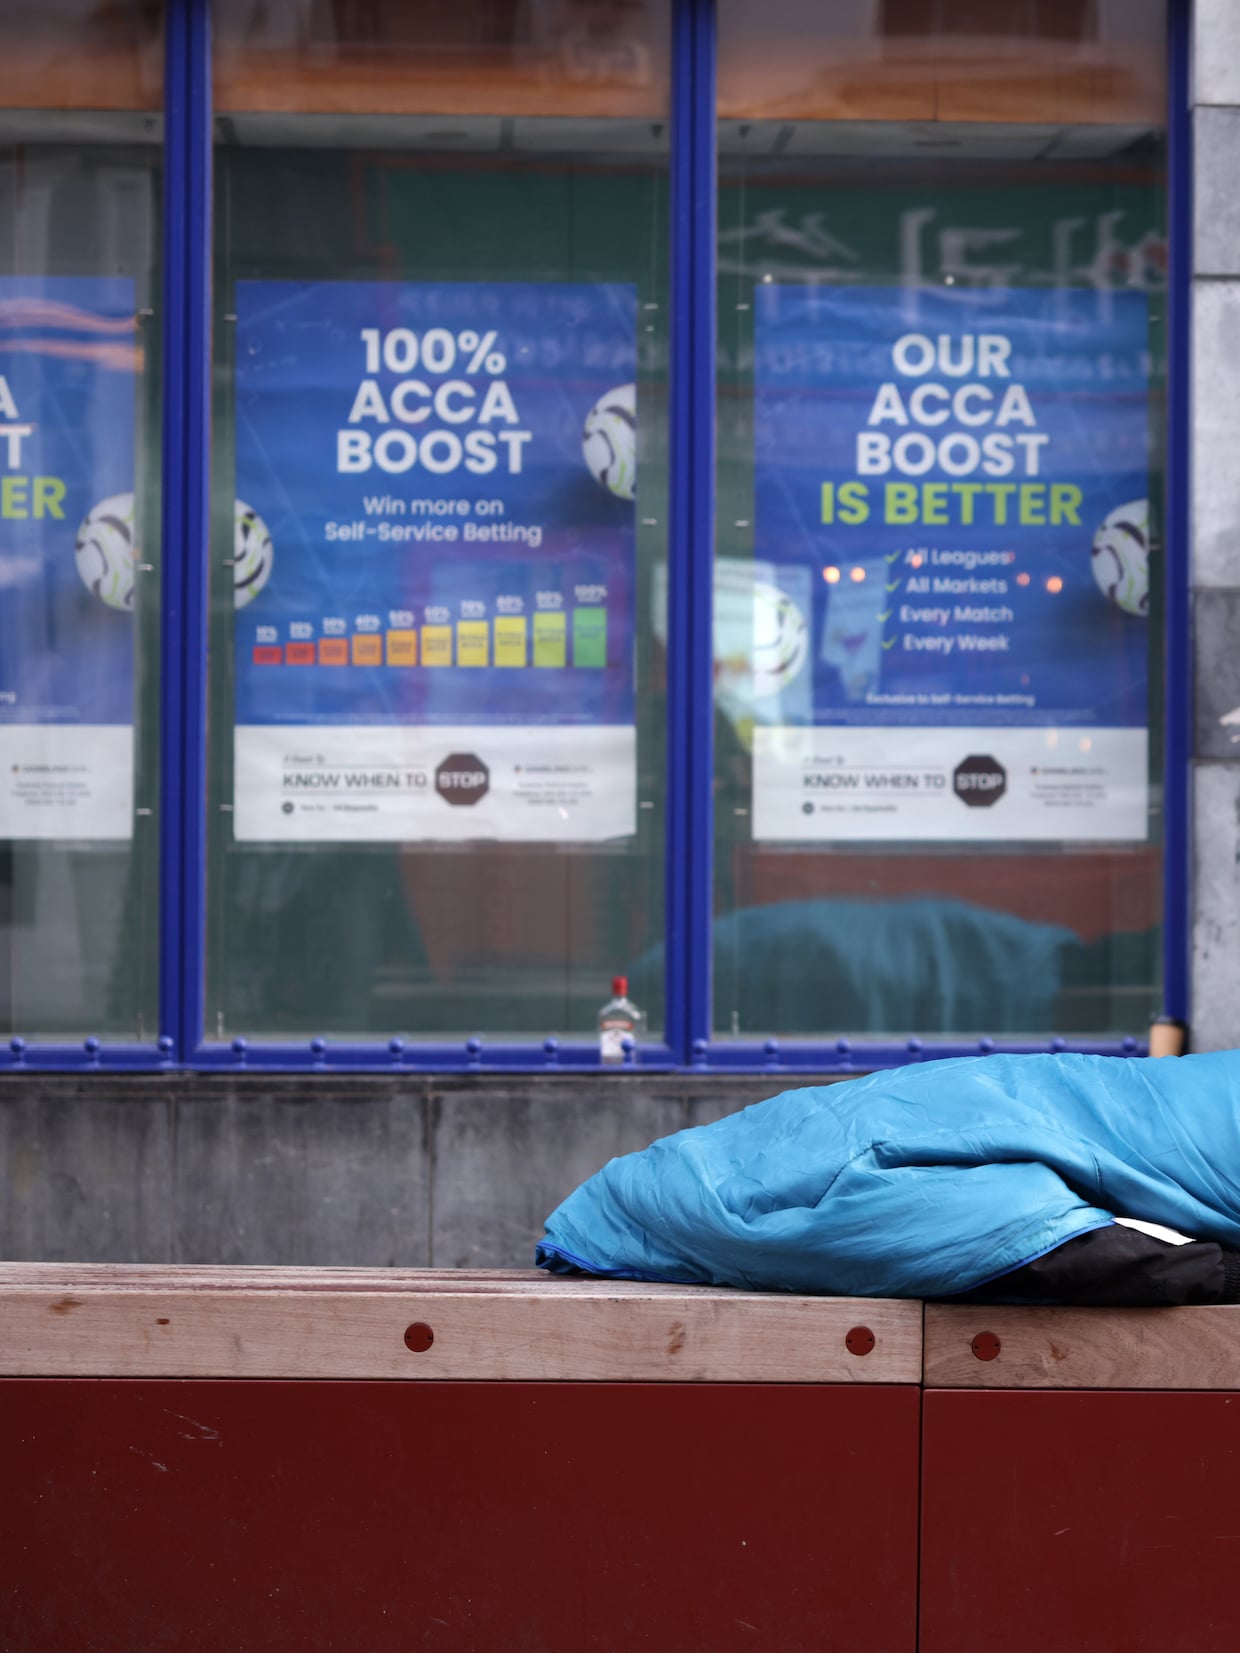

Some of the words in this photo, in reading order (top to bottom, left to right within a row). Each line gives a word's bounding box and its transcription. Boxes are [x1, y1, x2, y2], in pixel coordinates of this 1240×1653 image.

[361, 328, 507, 375] 100%
[892, 333, 1012, 377] OUR
[348, 379, 520, 424] ACCA
[867, 383, 1037, 427] ACCA
[336, 429, 533, 475] BOOST
[856, 432, 1049, 477] BOOST
[1, 476, 67, 520] ER
[363, 496, 405, 516] Win
[411, 500, 470, 516] more
[475, 500, 504, 516] on
[821, 481, 870, 526] IS
[884, 482, 1083, 526] BETTER
[325, 522, 459, 542] Self-Service
[463, 522, 542, 547] Betting
[905, 548, 928, 565] All
[931, 548, 1010, 569] Leagues
[906, 577, 931, 594] All
[934, 577, 1008, 594] Markets
[900, 606, 949, 627] Every
[954, 605, 1013, 622] Match
[903, 634, 952, 655] Every
[957, 634, 1010, 650] Week
[283, 773, 339, 788] KNOW
[344, 773, 400, 788] WHEN
[405, 773, 427, 788] TO
[439, 771, 486, 789] STOP
[804, 774, 860, 789] KNOW
[864, 774, 919, 789] WHEN
[924, 774, 946, 789] TO
[956, 773, 1004, 790] STOP
